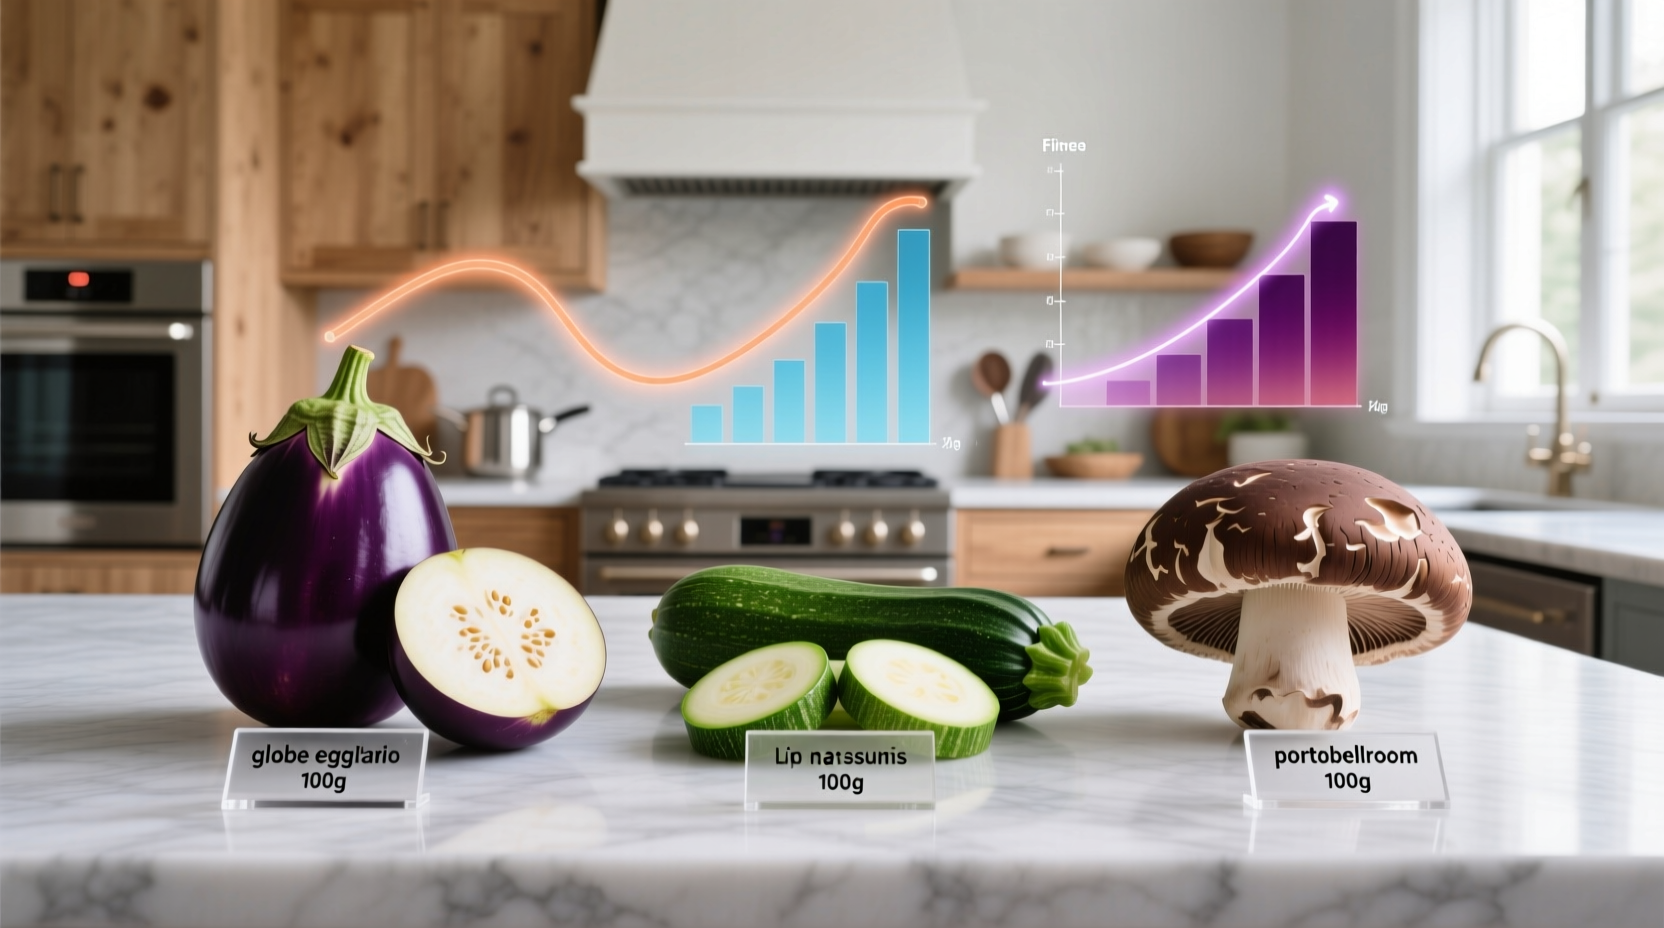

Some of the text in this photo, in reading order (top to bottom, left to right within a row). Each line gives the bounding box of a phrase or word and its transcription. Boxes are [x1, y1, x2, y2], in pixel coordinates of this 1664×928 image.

[251, 743, 310, 769] globe
[1274, 744, 1419, 770] portobellroom
[301, 772, 347, 794] 100g
[818, 773, 864, 795] 100g
[1324, 772, 1372, 794] 100g
